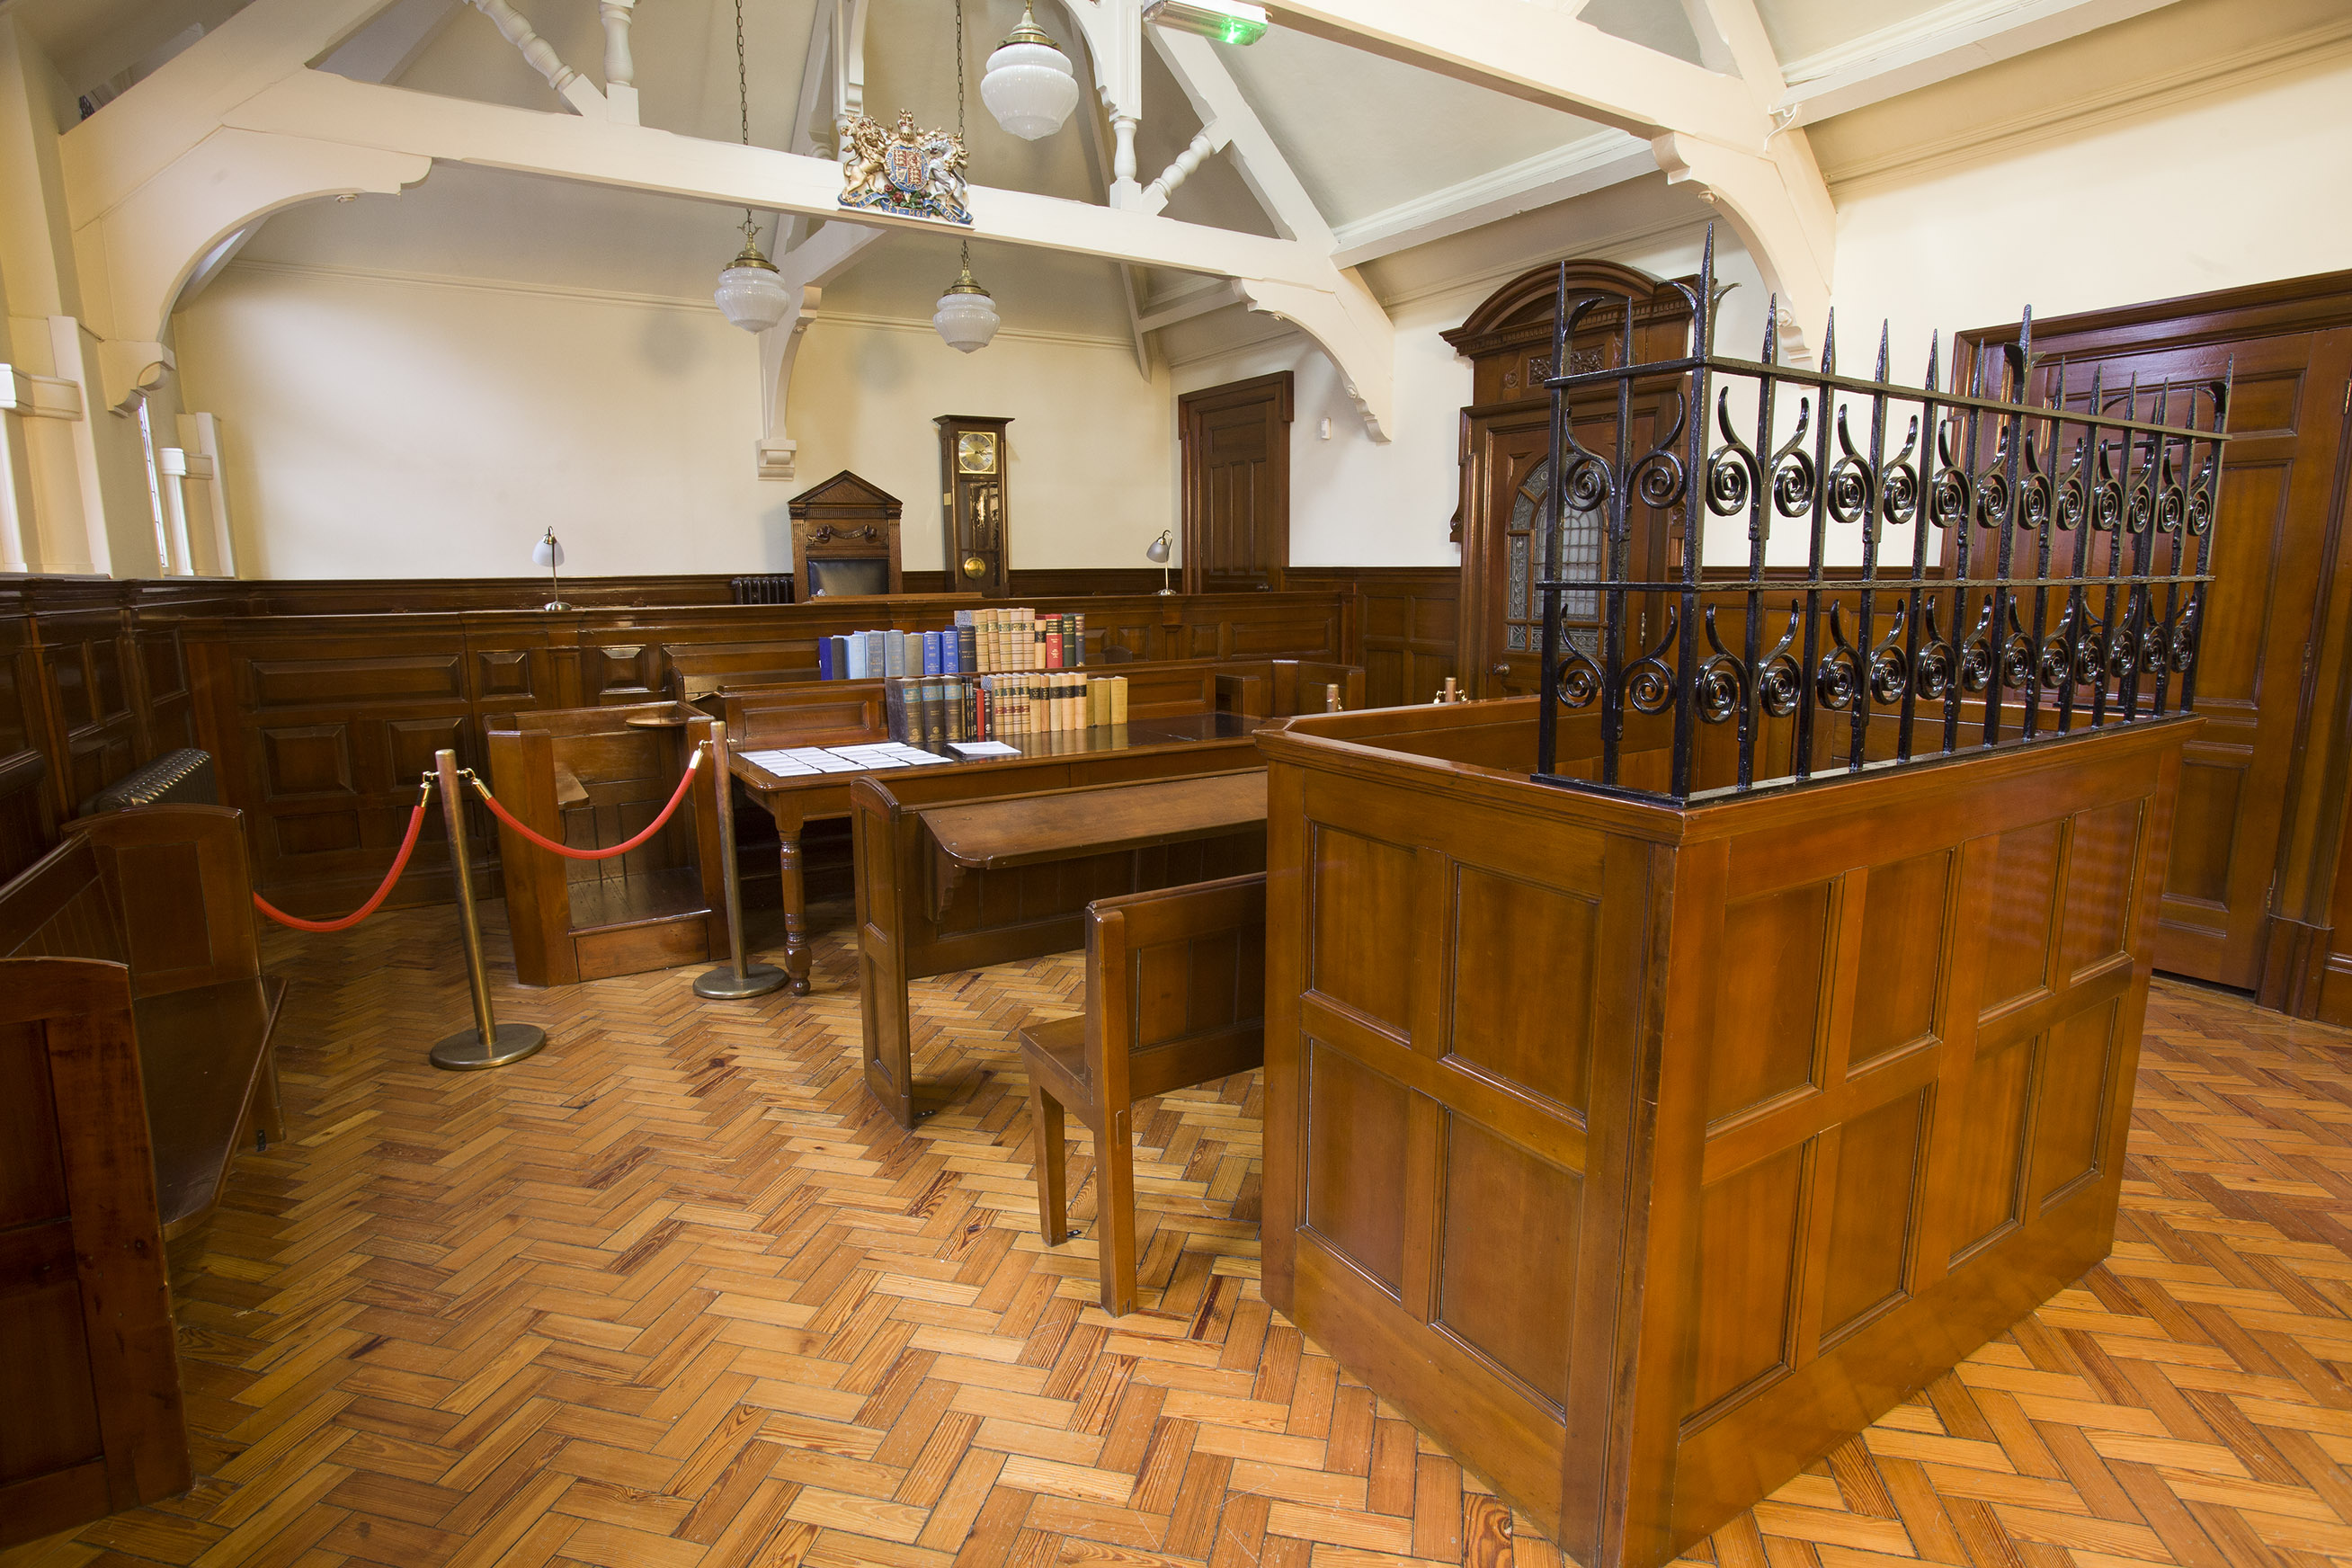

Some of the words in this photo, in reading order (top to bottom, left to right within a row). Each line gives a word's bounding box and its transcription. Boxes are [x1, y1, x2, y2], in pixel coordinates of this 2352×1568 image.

[852, 194, 874, 208] DIEU
[908, 208, 928, 218] MON
[932, 200, 960, 223] DROIT
